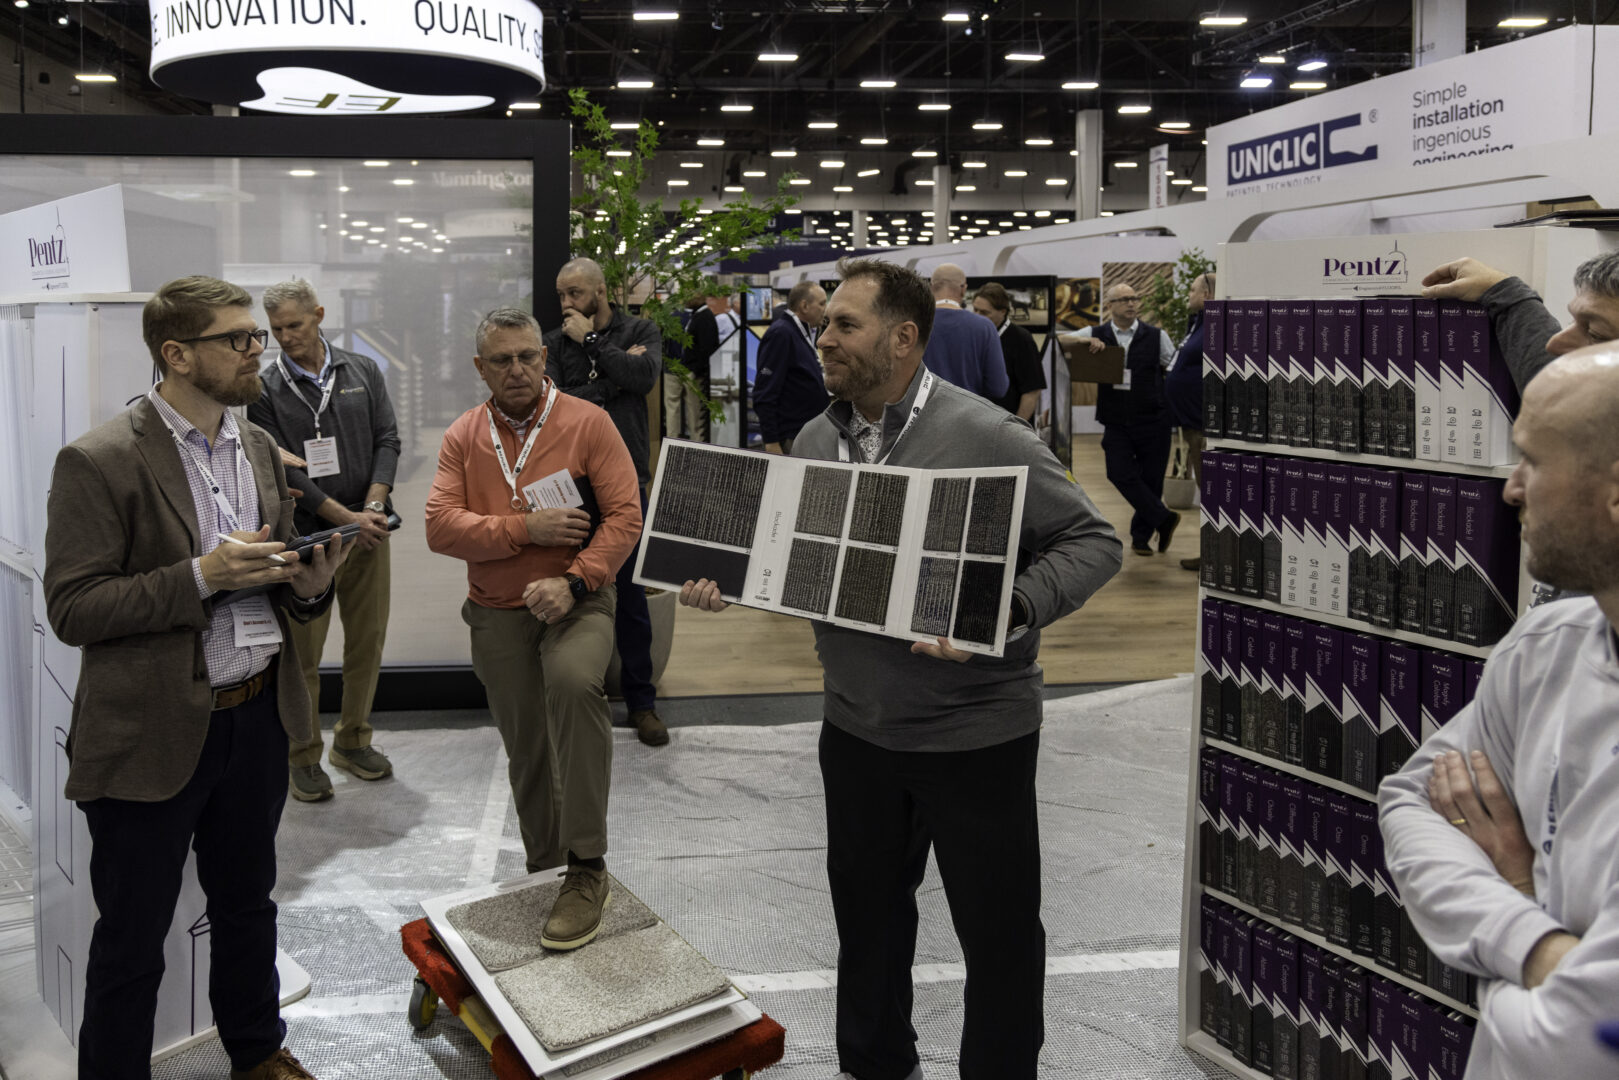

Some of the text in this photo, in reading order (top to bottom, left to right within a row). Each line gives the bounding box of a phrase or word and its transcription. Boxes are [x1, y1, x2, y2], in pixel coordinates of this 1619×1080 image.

[414, 0, 530, 52] QUALITY.
[1412, 81, 1467, 109] Simple
[1412, 99, 1504, 130] installation
[1412, 125, 1492, 153] ingenious
[1230, 132, 1316, 180] UNICLIC
[1266, 175, 1322, 192] TECHNOLOGY
[28, 234, 66, 268] Pentz
[1323, 256, 1402, 277] Pentz
